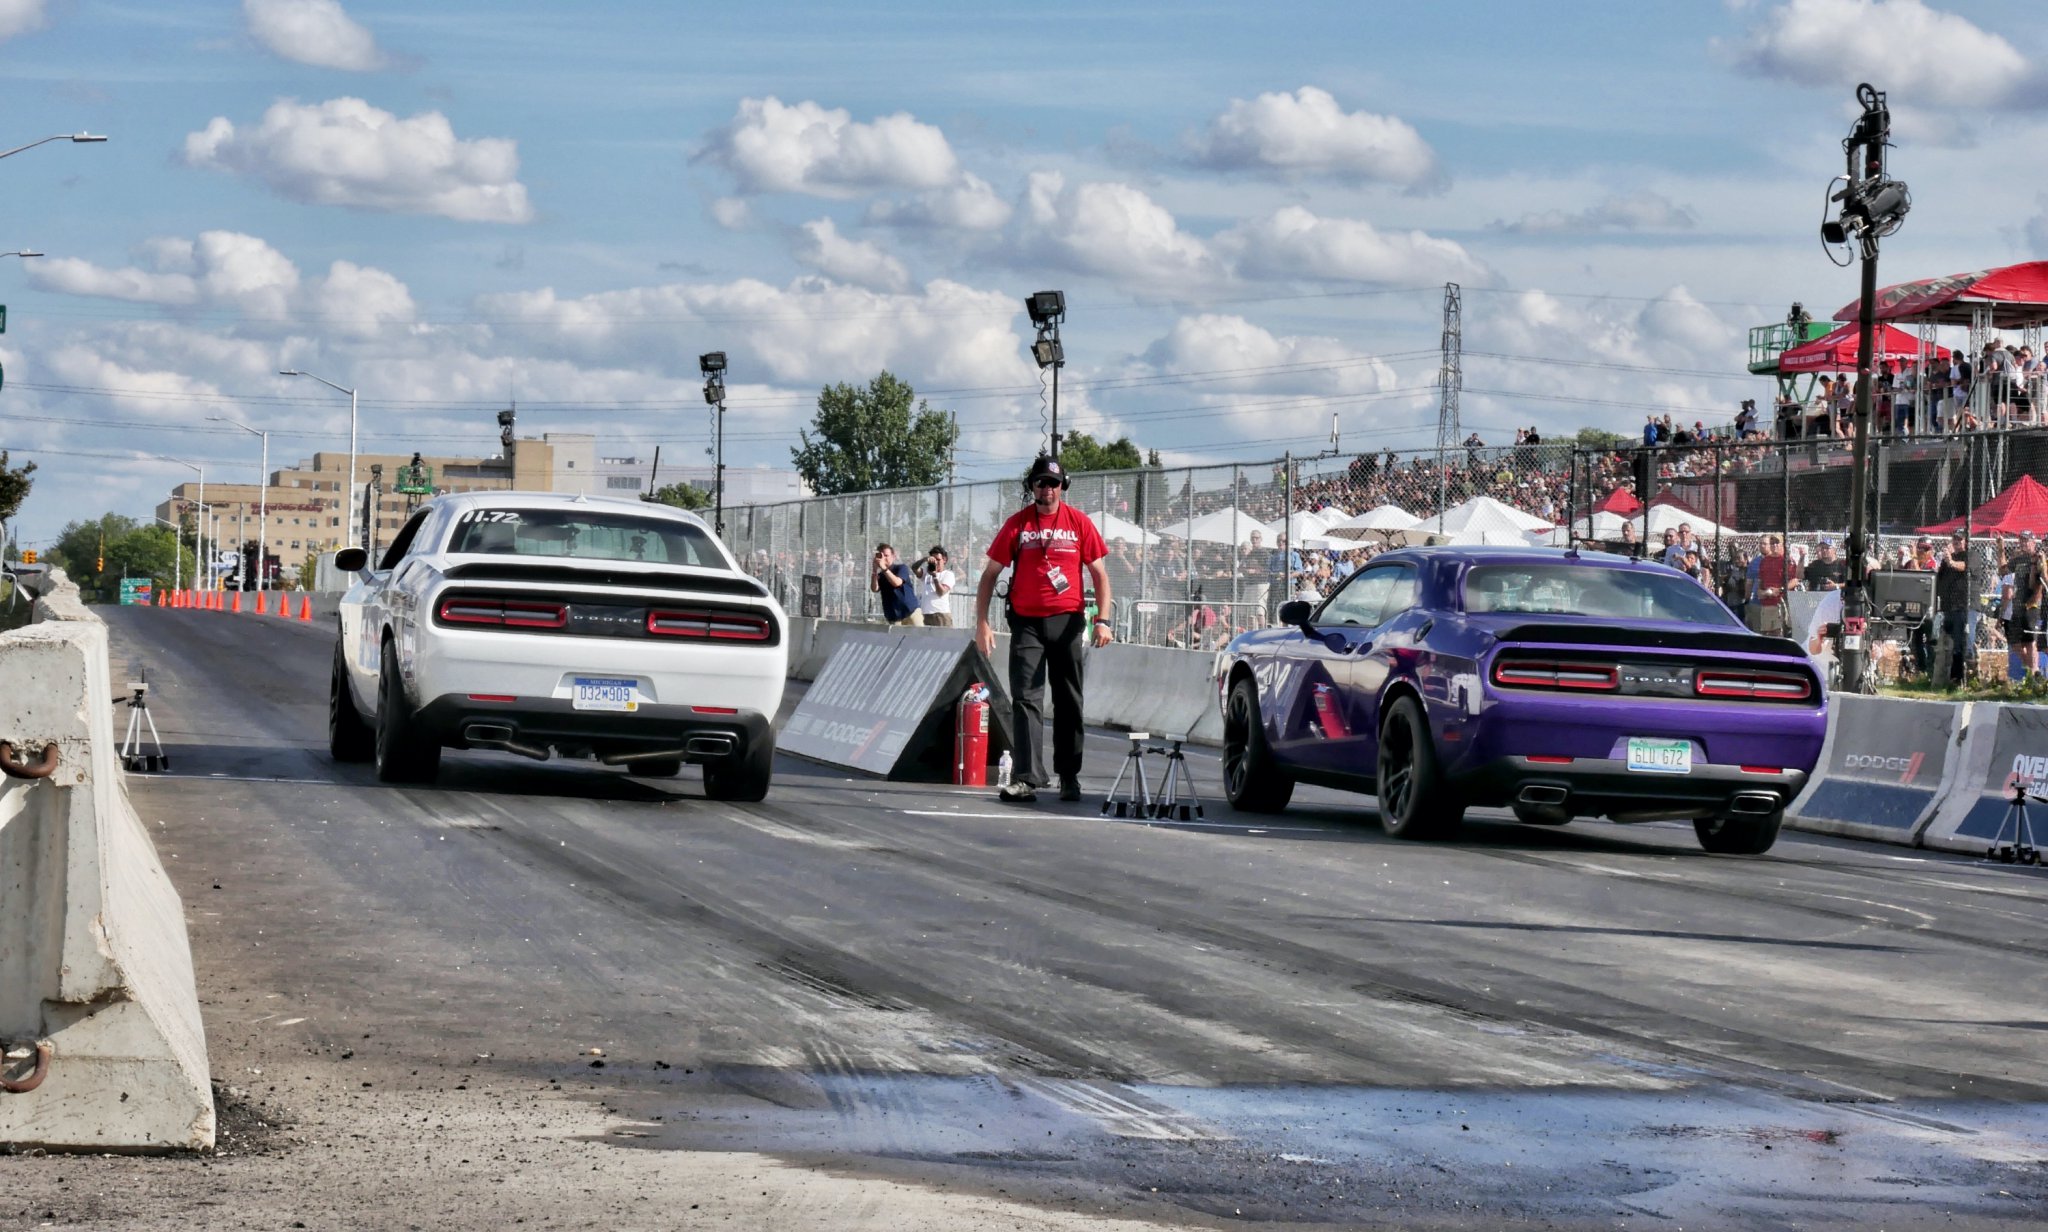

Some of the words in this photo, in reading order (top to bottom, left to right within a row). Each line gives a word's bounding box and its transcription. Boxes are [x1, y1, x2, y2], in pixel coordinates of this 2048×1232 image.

[1020, 528, 1078, 544] ROADKILL
[574, 615, 642, 623] DODGE
[1625, 676, 1690, 684] DODGE
[824, 720, 872, 746] DODGE
[1845, 754, 1913, 771] DODGE
[2025, 781, 2048, 798] GEA
